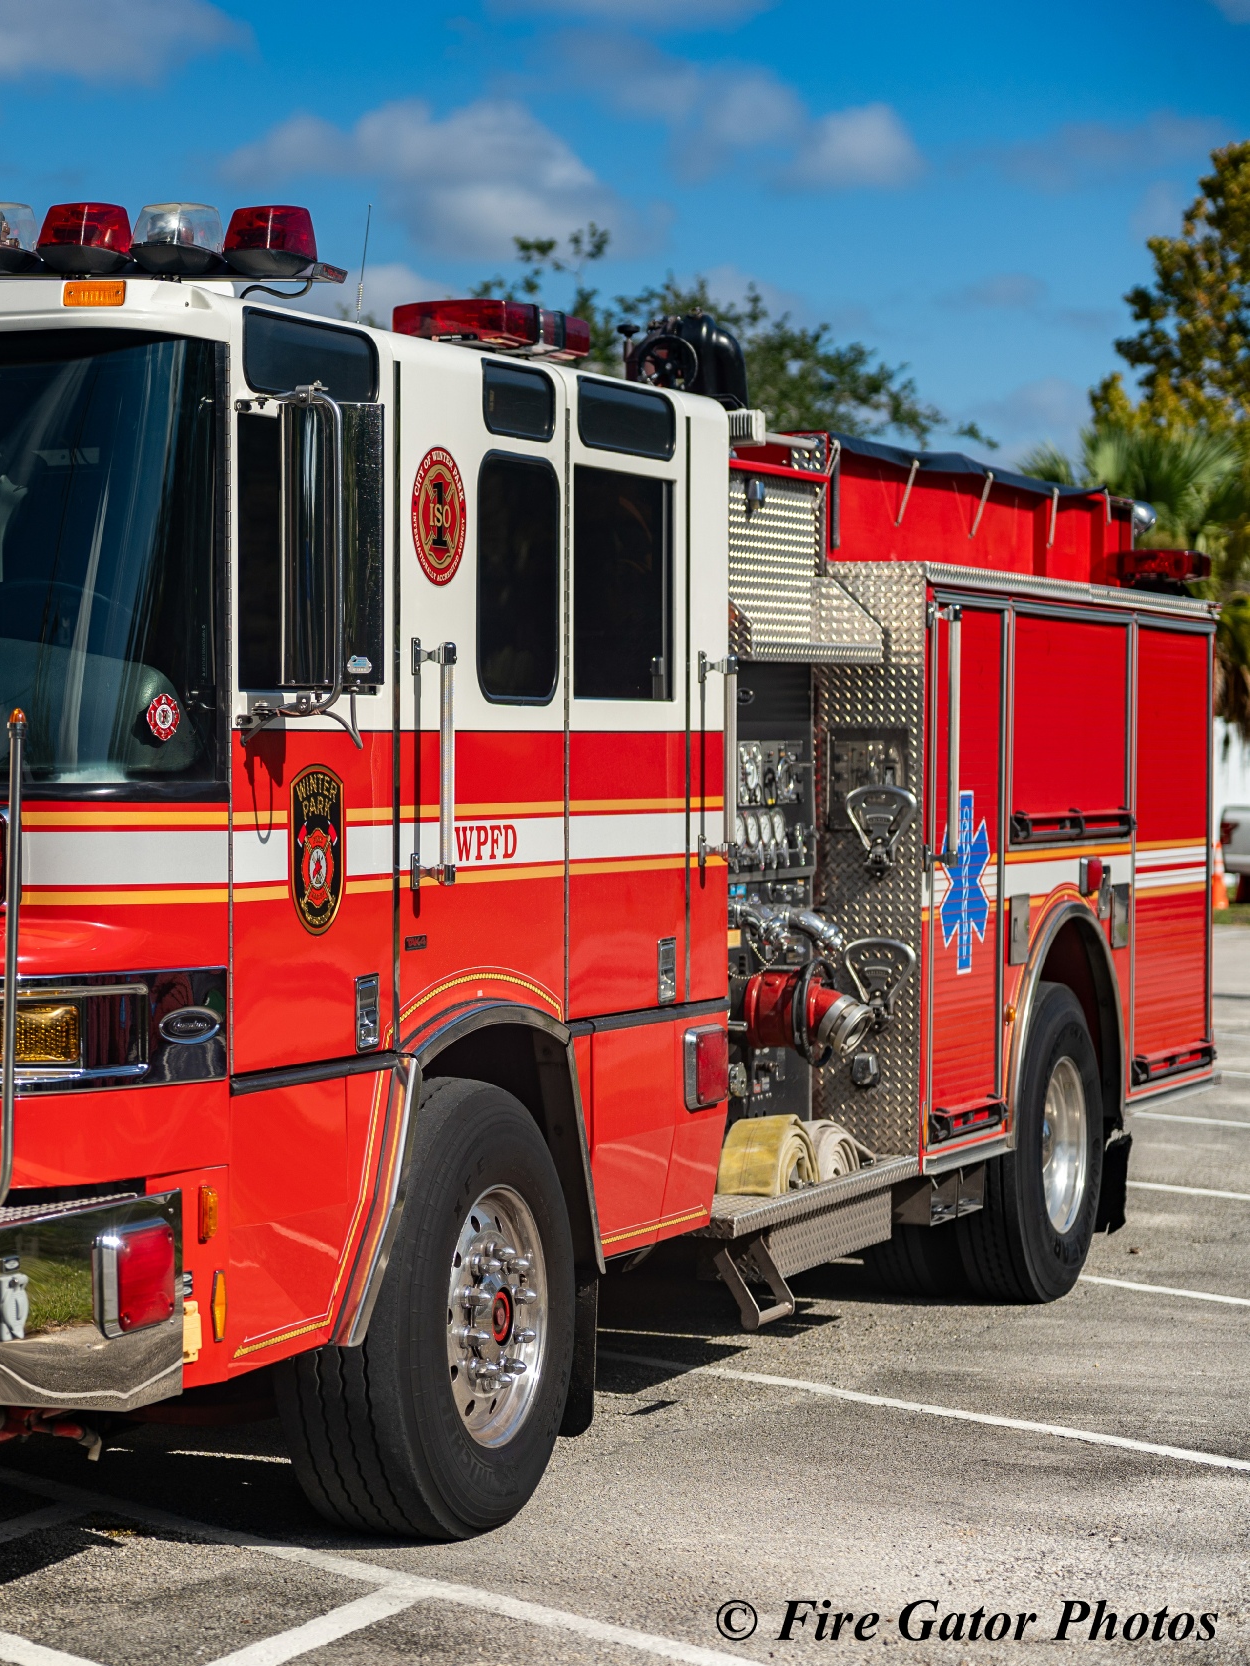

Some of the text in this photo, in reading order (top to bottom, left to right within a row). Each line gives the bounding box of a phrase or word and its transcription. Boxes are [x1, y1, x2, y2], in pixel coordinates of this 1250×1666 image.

[414, 450, 465, 503] CITY OF WINTER PARK
[429, 503, 451, 527] ISO
[296, 773, 338, 803] WINTER
[301, 795, 333, 821] PARK
[454, 823, 518, 862] WPFD
